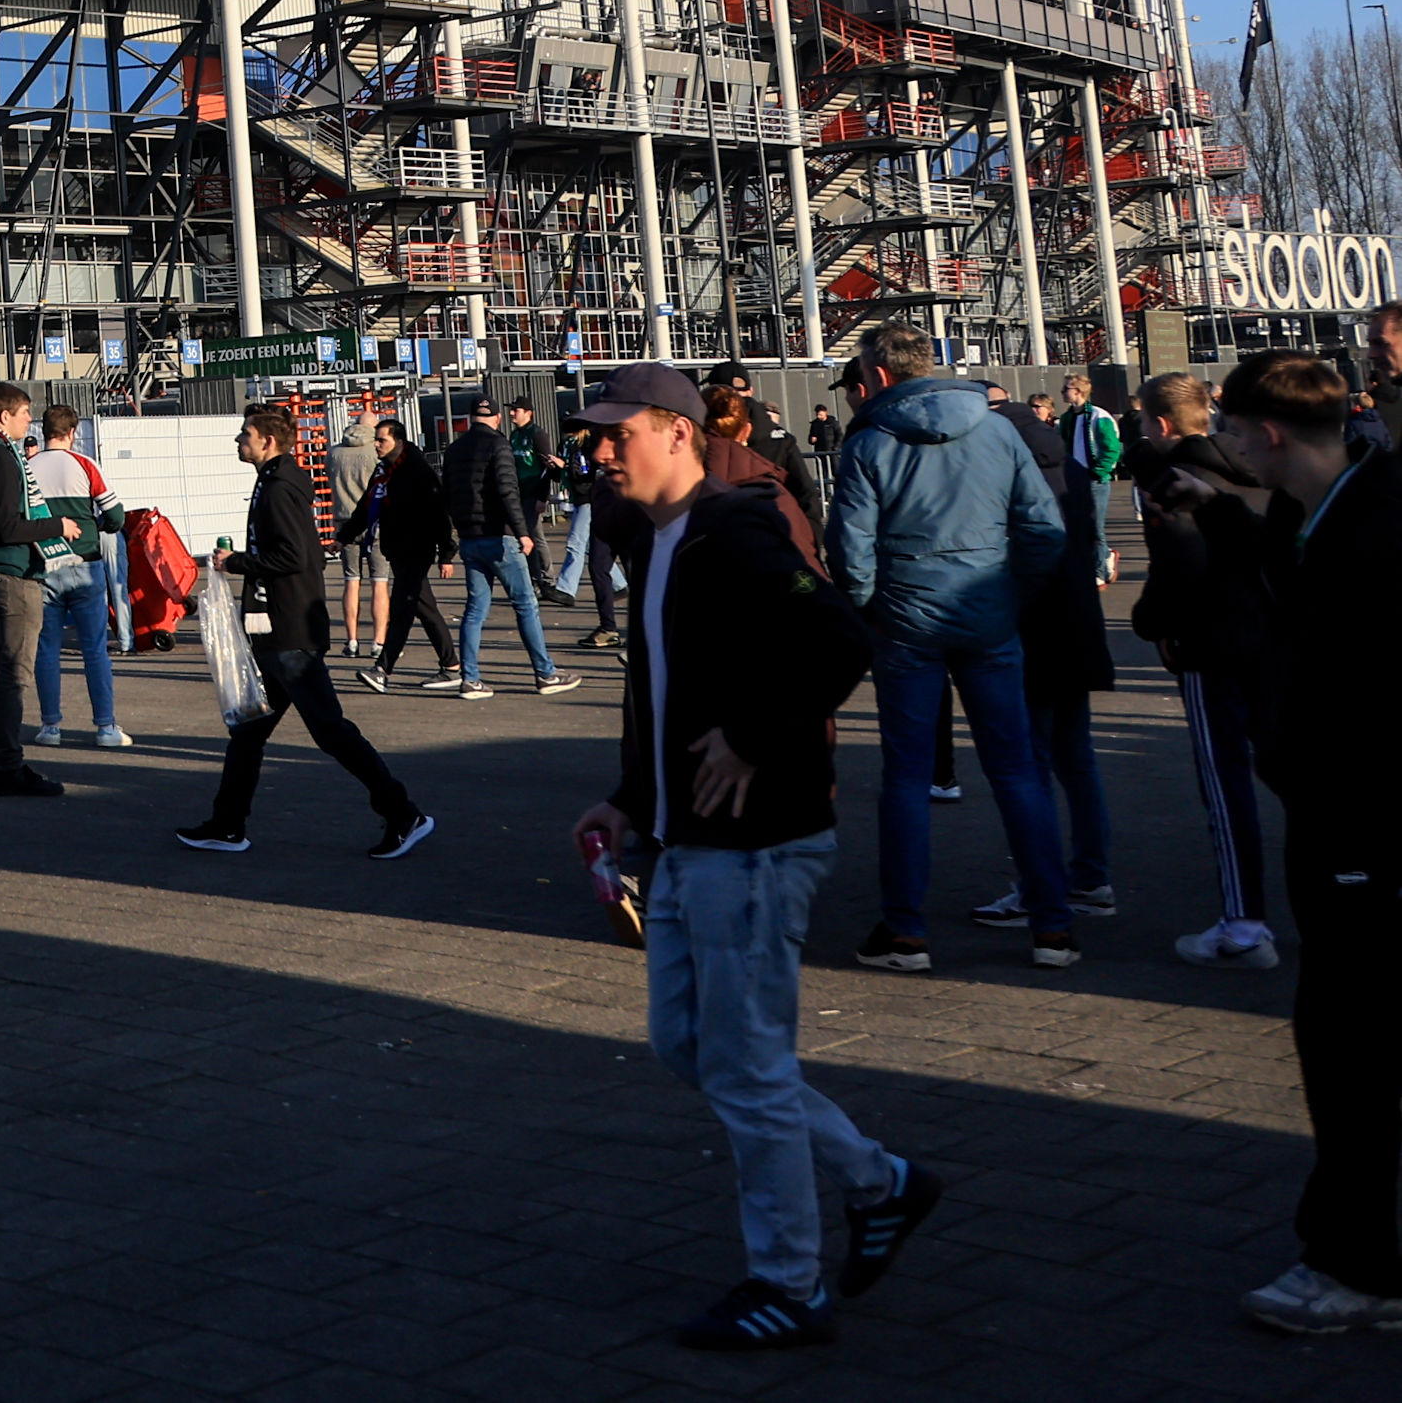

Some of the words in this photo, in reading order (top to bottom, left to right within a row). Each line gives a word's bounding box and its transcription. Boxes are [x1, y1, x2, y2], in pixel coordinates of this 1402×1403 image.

[1224, 203, 1397, 310] stadion
[48, 345, 61, 358] 34
[108, 346, 121, 360] 35
[186, 347, 197, 359] 36
[204, 350, 217, 364] JE
[218, 347, 255, 363] ZOEKT
[258, 344, 280, 359] EEN
[323, 343, 332, 355] 37
[363, 343, 373, 355] 38
[400, 345, 410, 357] 39
[462, 344, 475, 356] 40
[291, 363, 305, 375] IN
[327, 359, 355, 373] ZON
